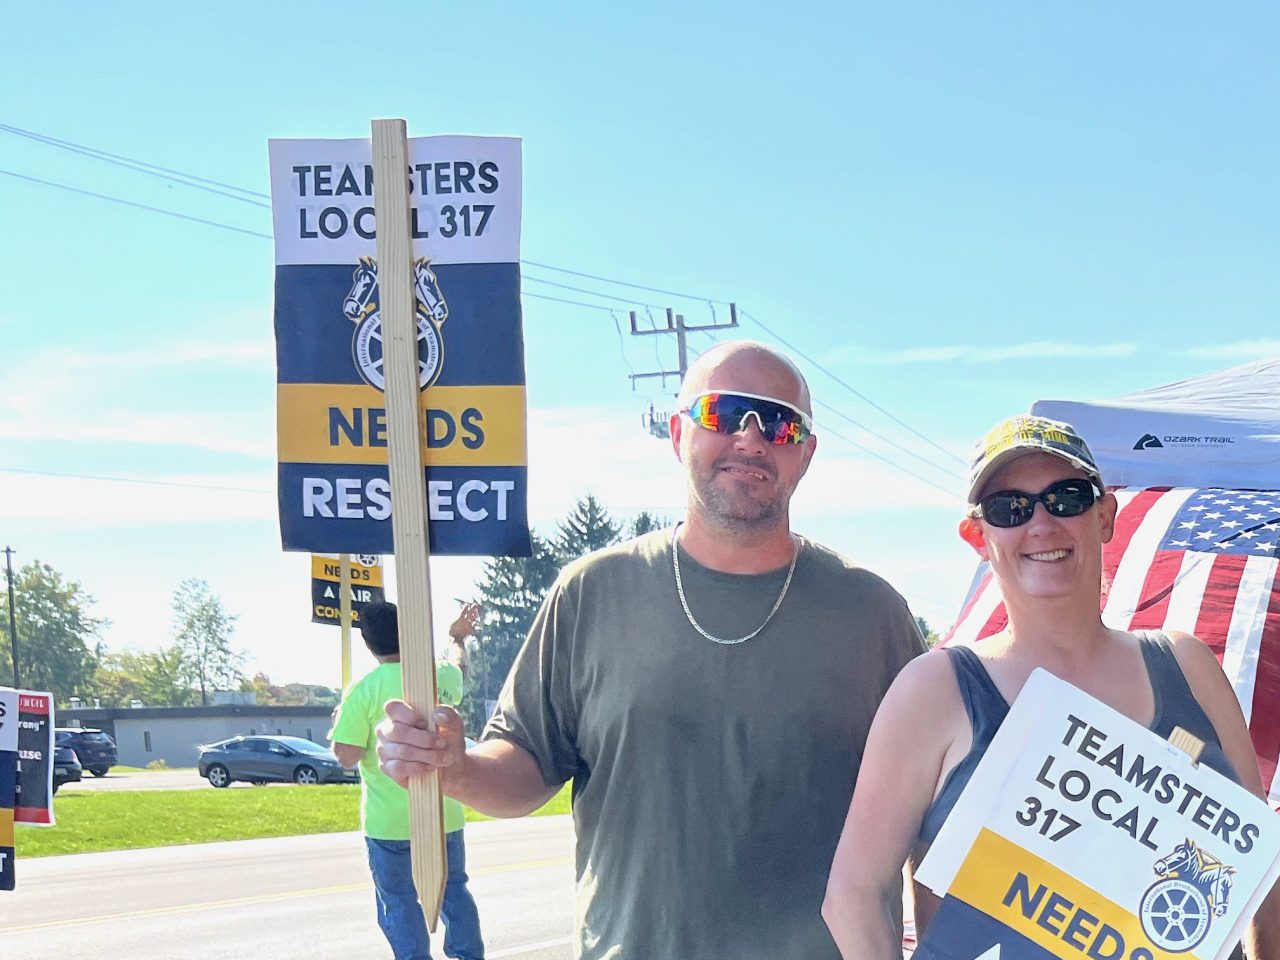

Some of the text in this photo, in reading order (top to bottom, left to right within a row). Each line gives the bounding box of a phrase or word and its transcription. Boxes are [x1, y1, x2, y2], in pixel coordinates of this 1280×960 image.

[293, 161, 499, 197] TEATERS
[300, 204, 495, 240] LOCL 317
[328, 406, 485, 450] NEDS
[302, 476, 515, 522] RESECT
[324, 564, 370, 580] NEDS
[323, 586, 335, 599] A
[339, 587, 372, 603] AIR
[1035, 755, 1159, 851] LOCAL
[1061, 713, 1261, 854] TEAMSTERS
[1015, 796, 1082, 843] 317
